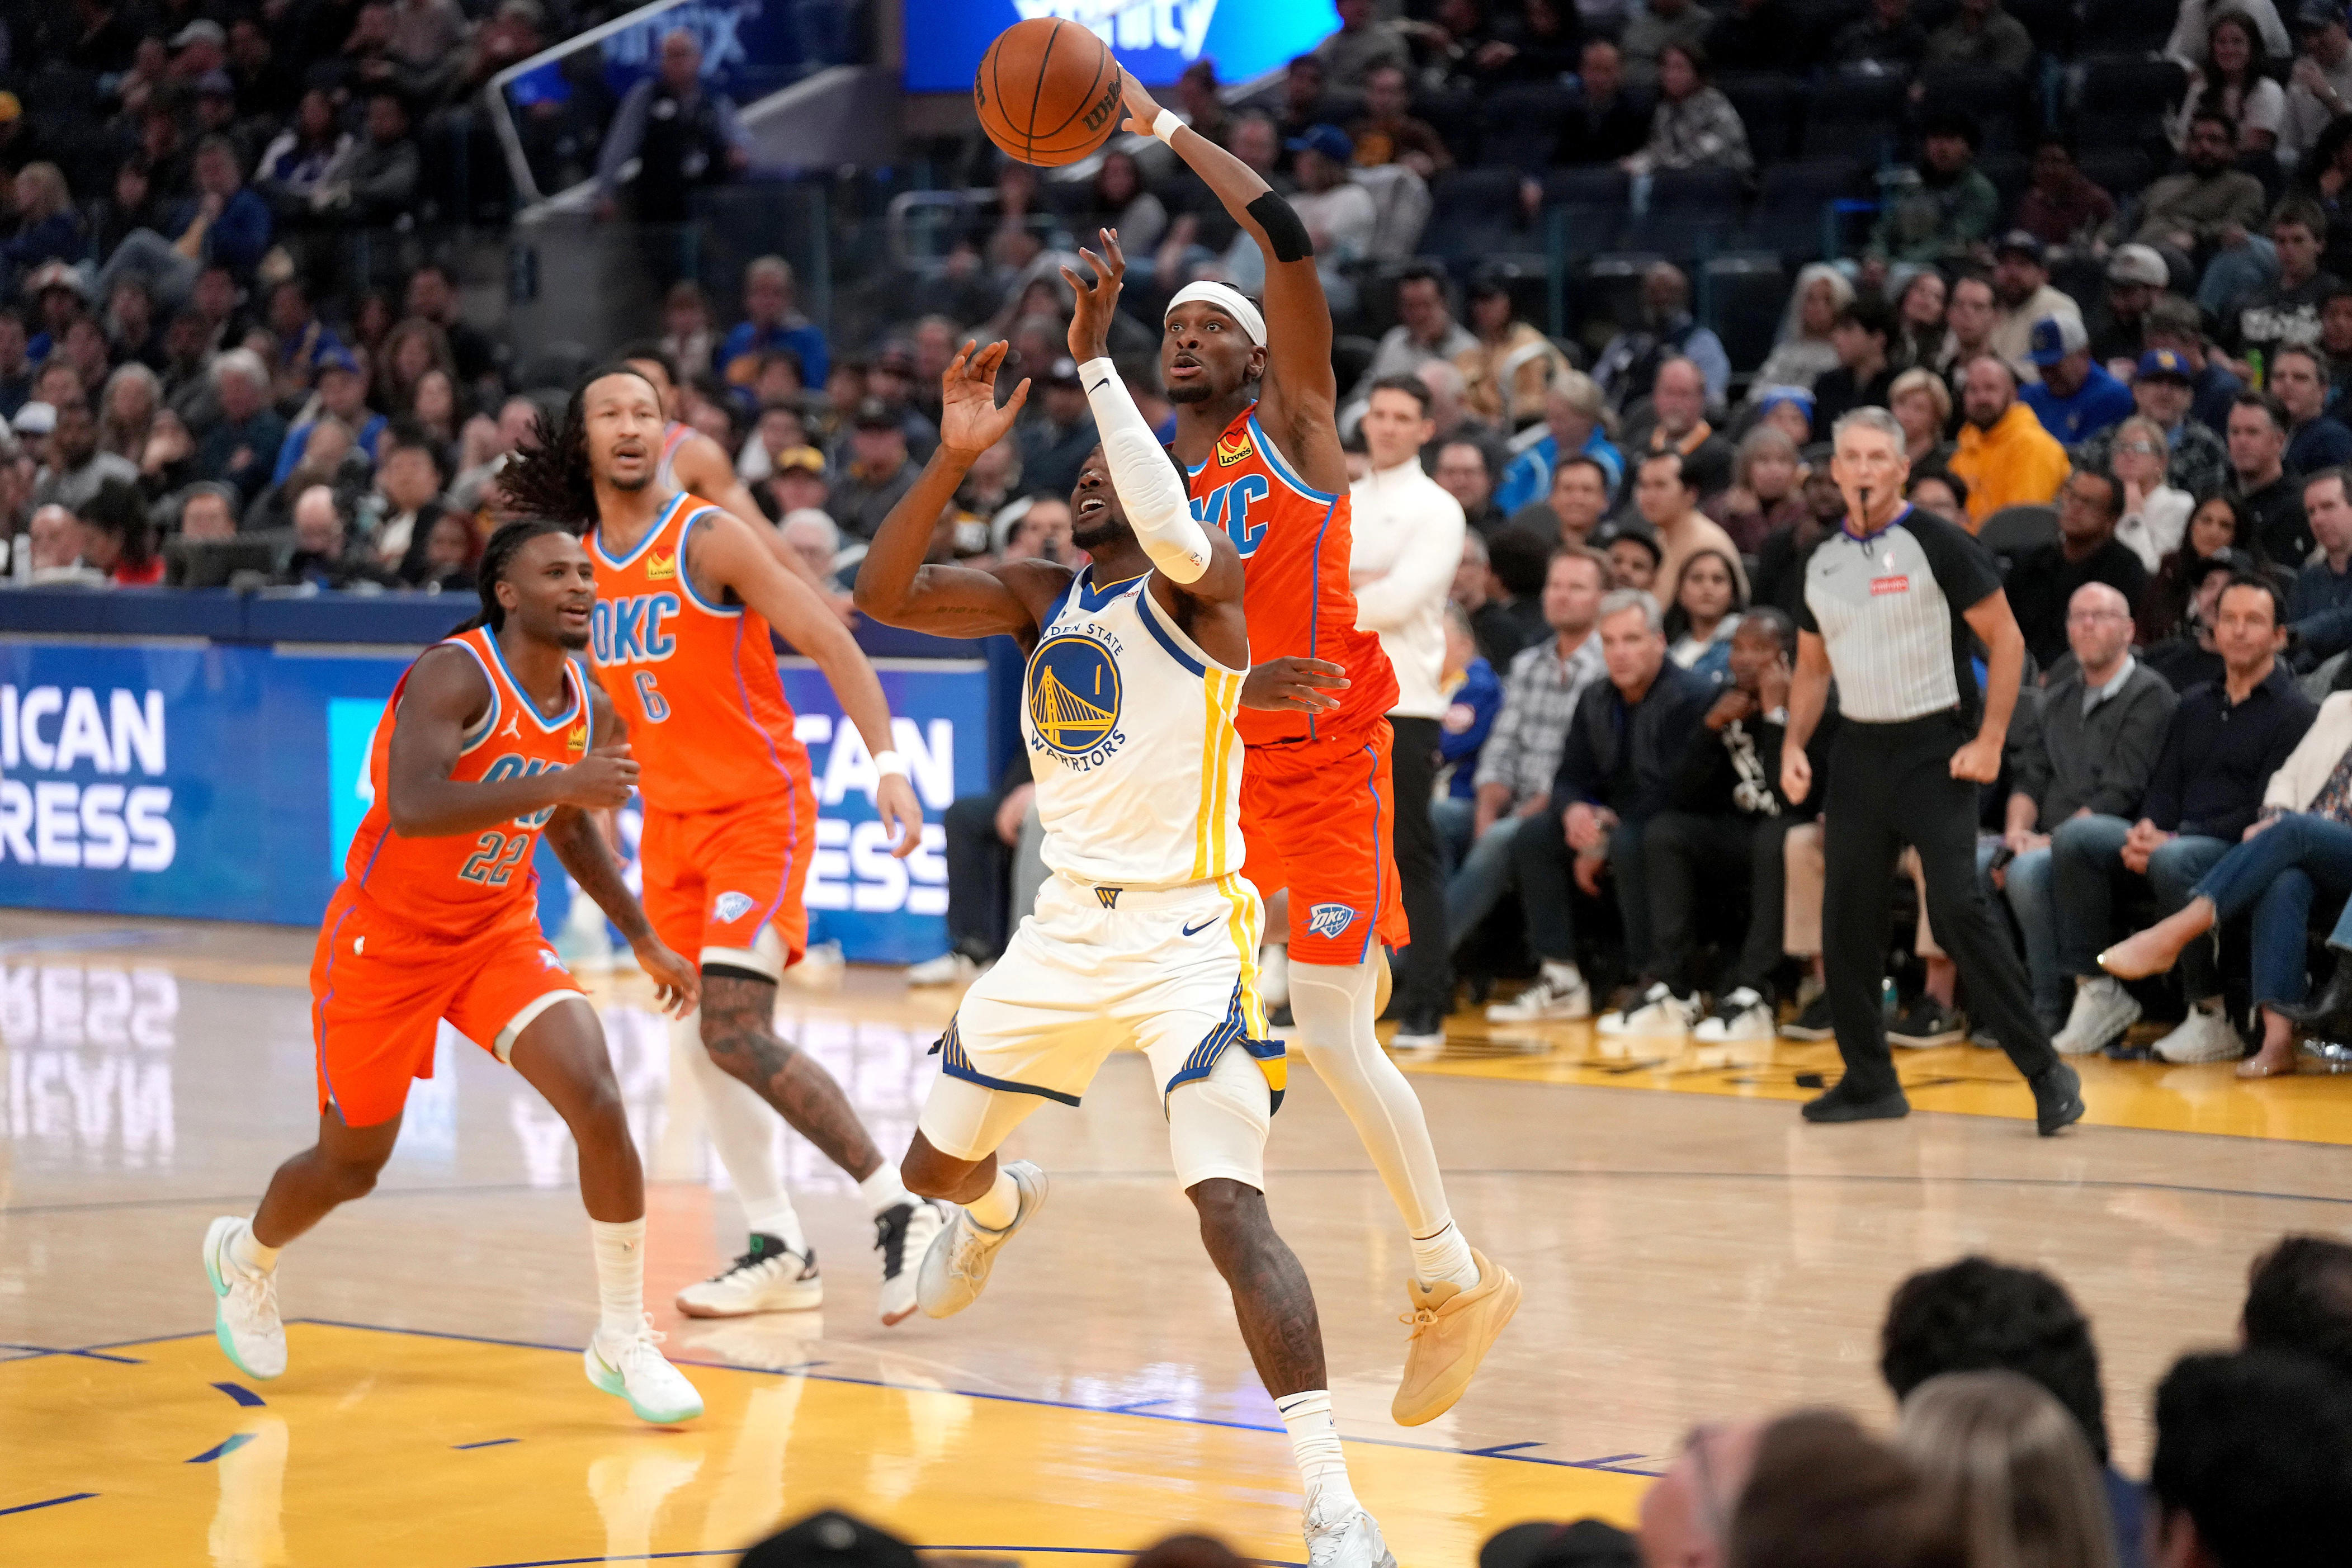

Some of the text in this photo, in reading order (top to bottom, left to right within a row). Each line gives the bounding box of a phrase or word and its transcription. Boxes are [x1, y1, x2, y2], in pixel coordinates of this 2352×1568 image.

[589, 591, 681, 667] OKC
[1087, 624, 1123, 657] STATE
[634, 670, 671, 724] 6
[1095, 664, 1102, 695] 1
[0, 684, 167, 776] ICAN
[1032, 729, 1126, 772] WARRIORS
[458, 831, 530, 886] 22
[1310, 910, 1346, 931] OKC
